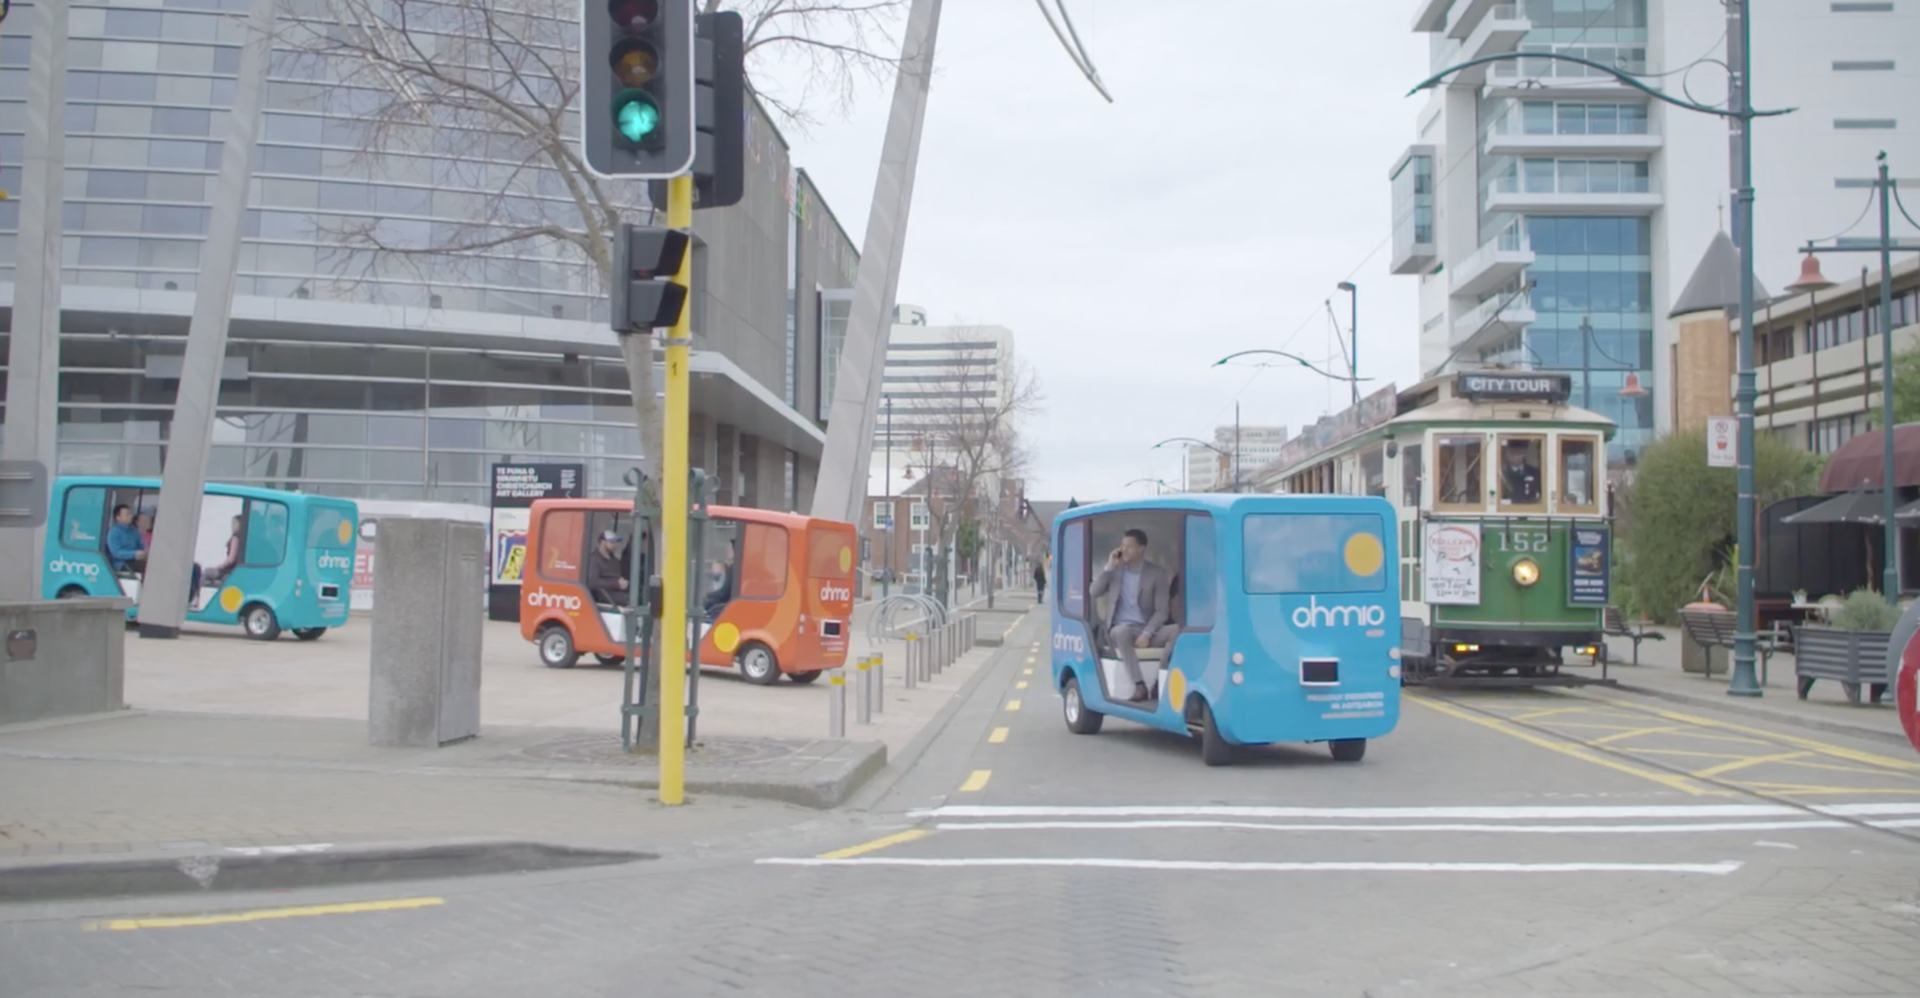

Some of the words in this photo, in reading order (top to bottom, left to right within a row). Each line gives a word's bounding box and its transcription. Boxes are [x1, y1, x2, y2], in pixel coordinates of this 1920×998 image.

[671, 361, 678, 377] 1
[1470, 377, 1505, 392] CITY
[1507, 378, 1551, 393] TOUR
[496, 467, 505, 475] TE
[528, 467, 536, 475] O
[496, 482, 553, 490] CHRISTCHURCH
[496, 489, 511, 497] ART
[511, 489, 545, 497] GALLERY
[1498, 531, 1549, 553] 152
[49, 554, 100, 576] ohmio
[319, 550, 351, 569] ohmio
[527, 586, 581, 610] ohmio
[820, 580, 850, 602] ohmio
[1292, 595, 1386, 628] ohmio
[1053, 624, 1084, 653] ohmio
